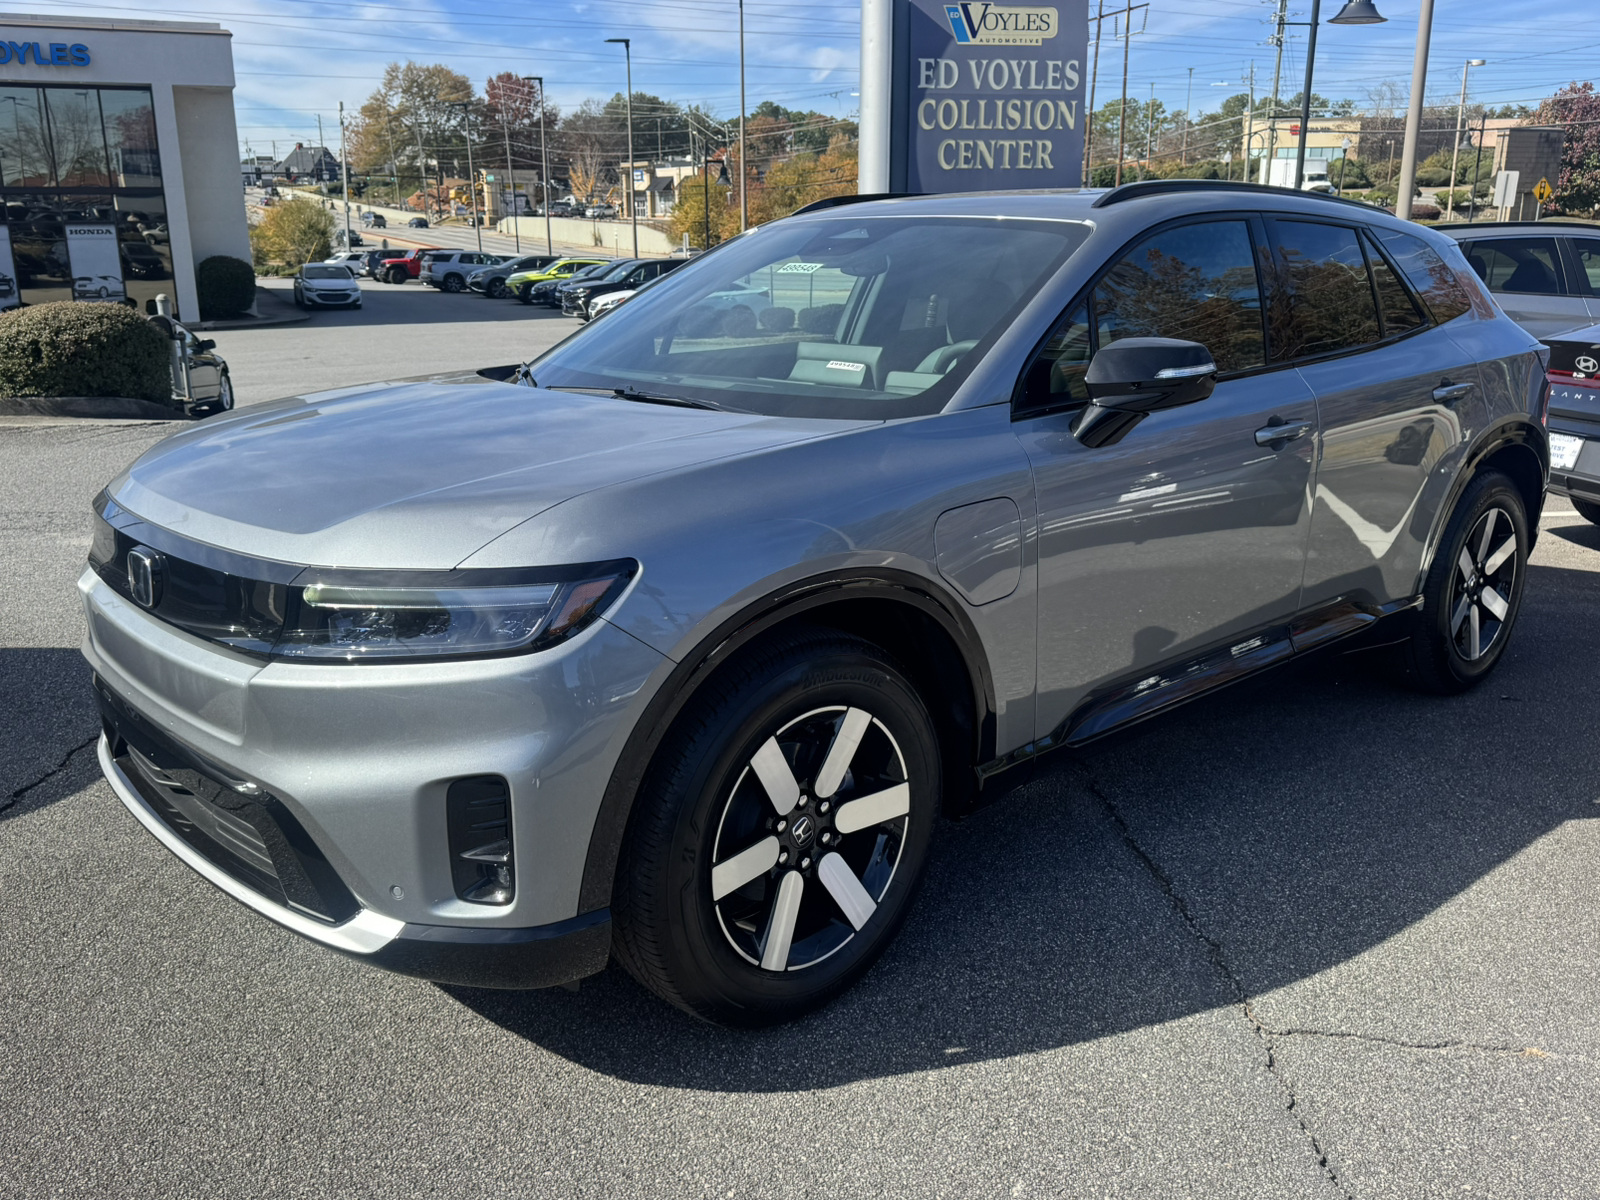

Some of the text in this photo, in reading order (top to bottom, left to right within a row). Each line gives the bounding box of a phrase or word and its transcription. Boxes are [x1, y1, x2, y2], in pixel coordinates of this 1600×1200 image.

[950, 3, 1050, 39] ED VOYLES
[917, 58, 1080, 91] ED VOYLES
[917, 98, 1078, 131] COLLISION
[937, 138, 1054, 171] CENTER
